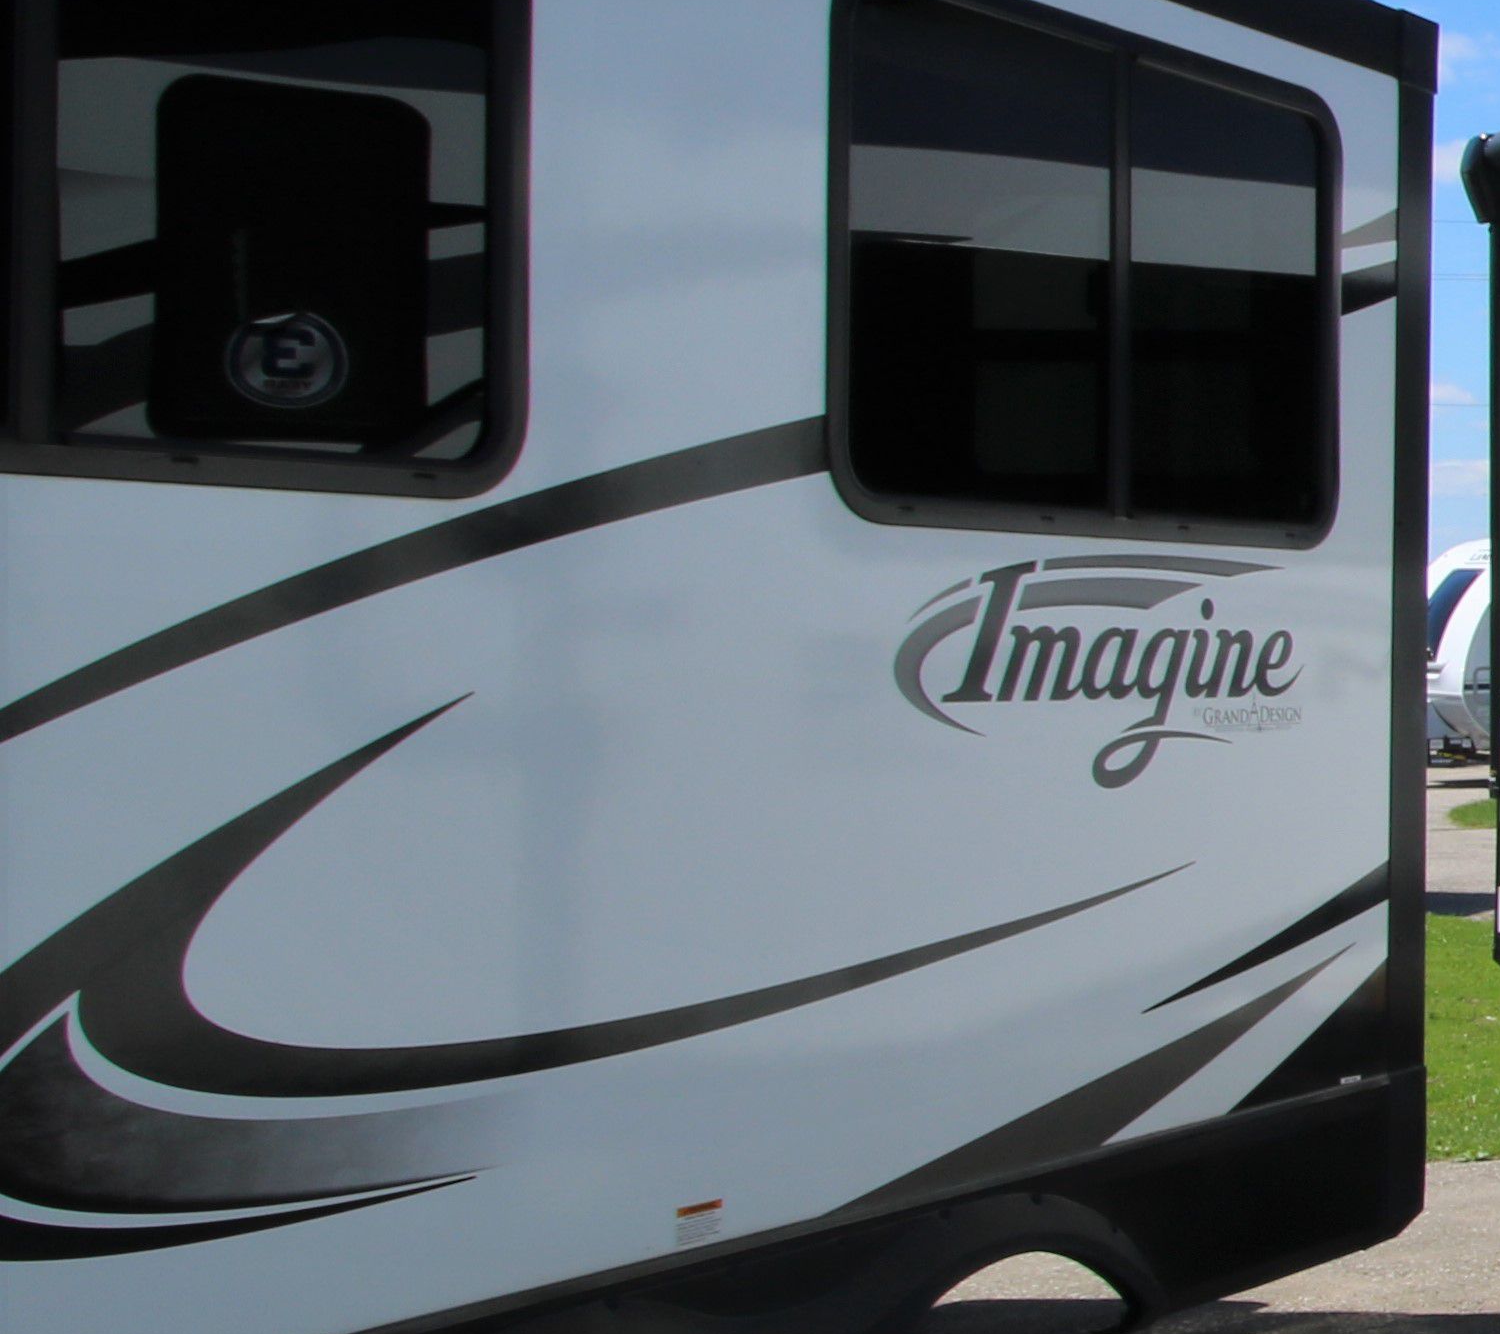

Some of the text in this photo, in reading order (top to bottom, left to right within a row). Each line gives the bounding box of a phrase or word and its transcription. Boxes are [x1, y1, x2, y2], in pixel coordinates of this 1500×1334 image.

[940, 559, 1305, 789] Imagine
[1202, 706, 1249, 725] GRAND
[1260, 705, 1302, 723] DESIGN
